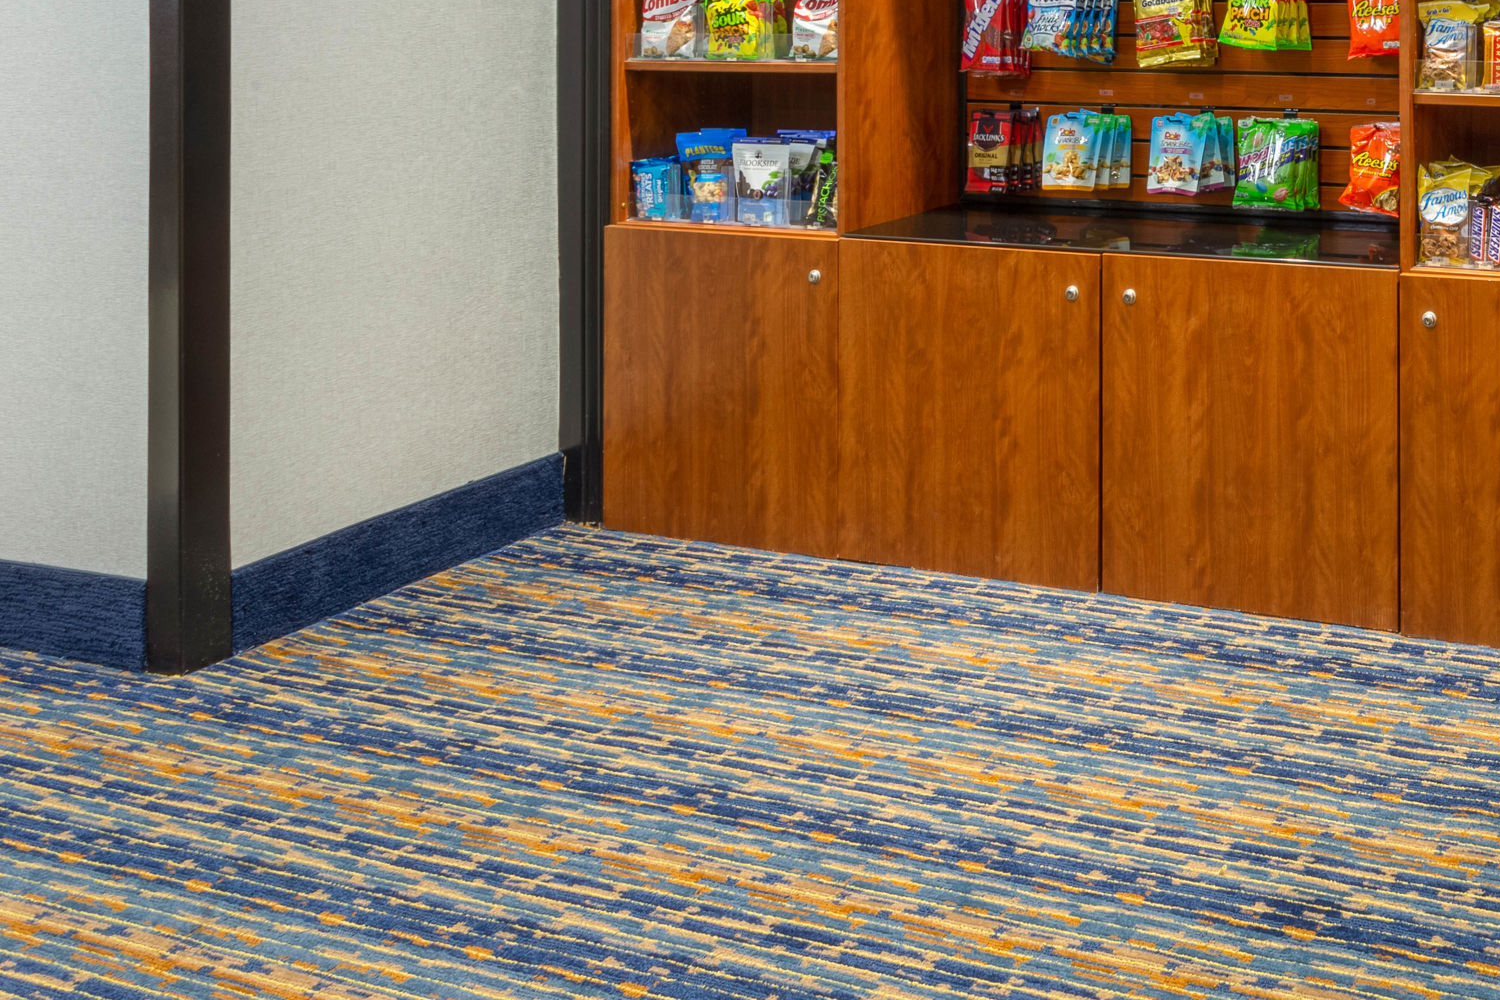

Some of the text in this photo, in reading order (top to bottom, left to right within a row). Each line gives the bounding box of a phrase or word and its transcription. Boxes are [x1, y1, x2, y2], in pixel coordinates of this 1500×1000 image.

[1231, 7, 1269, 21] PATCH
[1352, 0, 1400, 17] Reese's
[712, 12, 746, 28] SOUR
[684, 145, 726, 158] PLANTERS
[1420, 189, 1468, 211] Famous
[1430, 202, 1468, 222] Amos
[1471, 206, 1484, 258] SNICKERS
